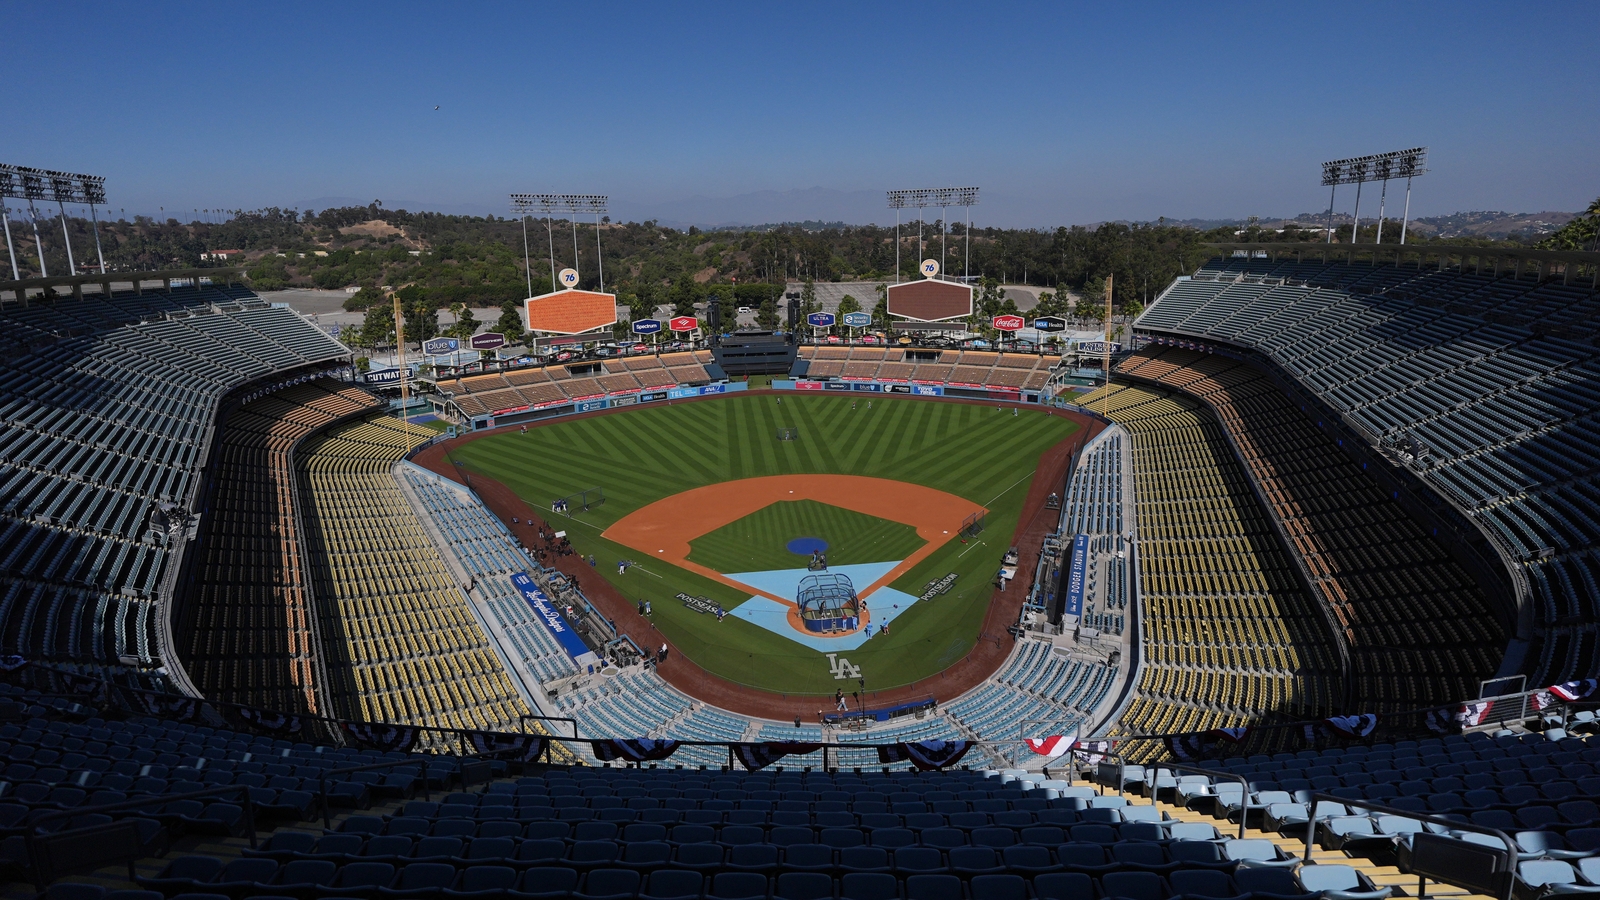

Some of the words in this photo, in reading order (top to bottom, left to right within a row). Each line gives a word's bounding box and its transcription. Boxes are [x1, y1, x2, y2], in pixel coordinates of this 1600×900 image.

[925, 264, 935, 272] 76
[565, 273, 575, 281] 76
[636, 322, 658, 330] Spectrum
[995, 318, 1020, 328] Coca-Cola
[427, 341, 448, 350] blue
[1074, 549, 1084, 570] STADIUM
[920, 572, 959, 602] POSTSEASON
[1071, 571, 1081, 593] DODGER
[525, 590, 542, 601] Los
[533, 598, 551, 617] Angeles
[546, 611, 566, 633] Dodgers
[825, 653, 862, 680] LA
